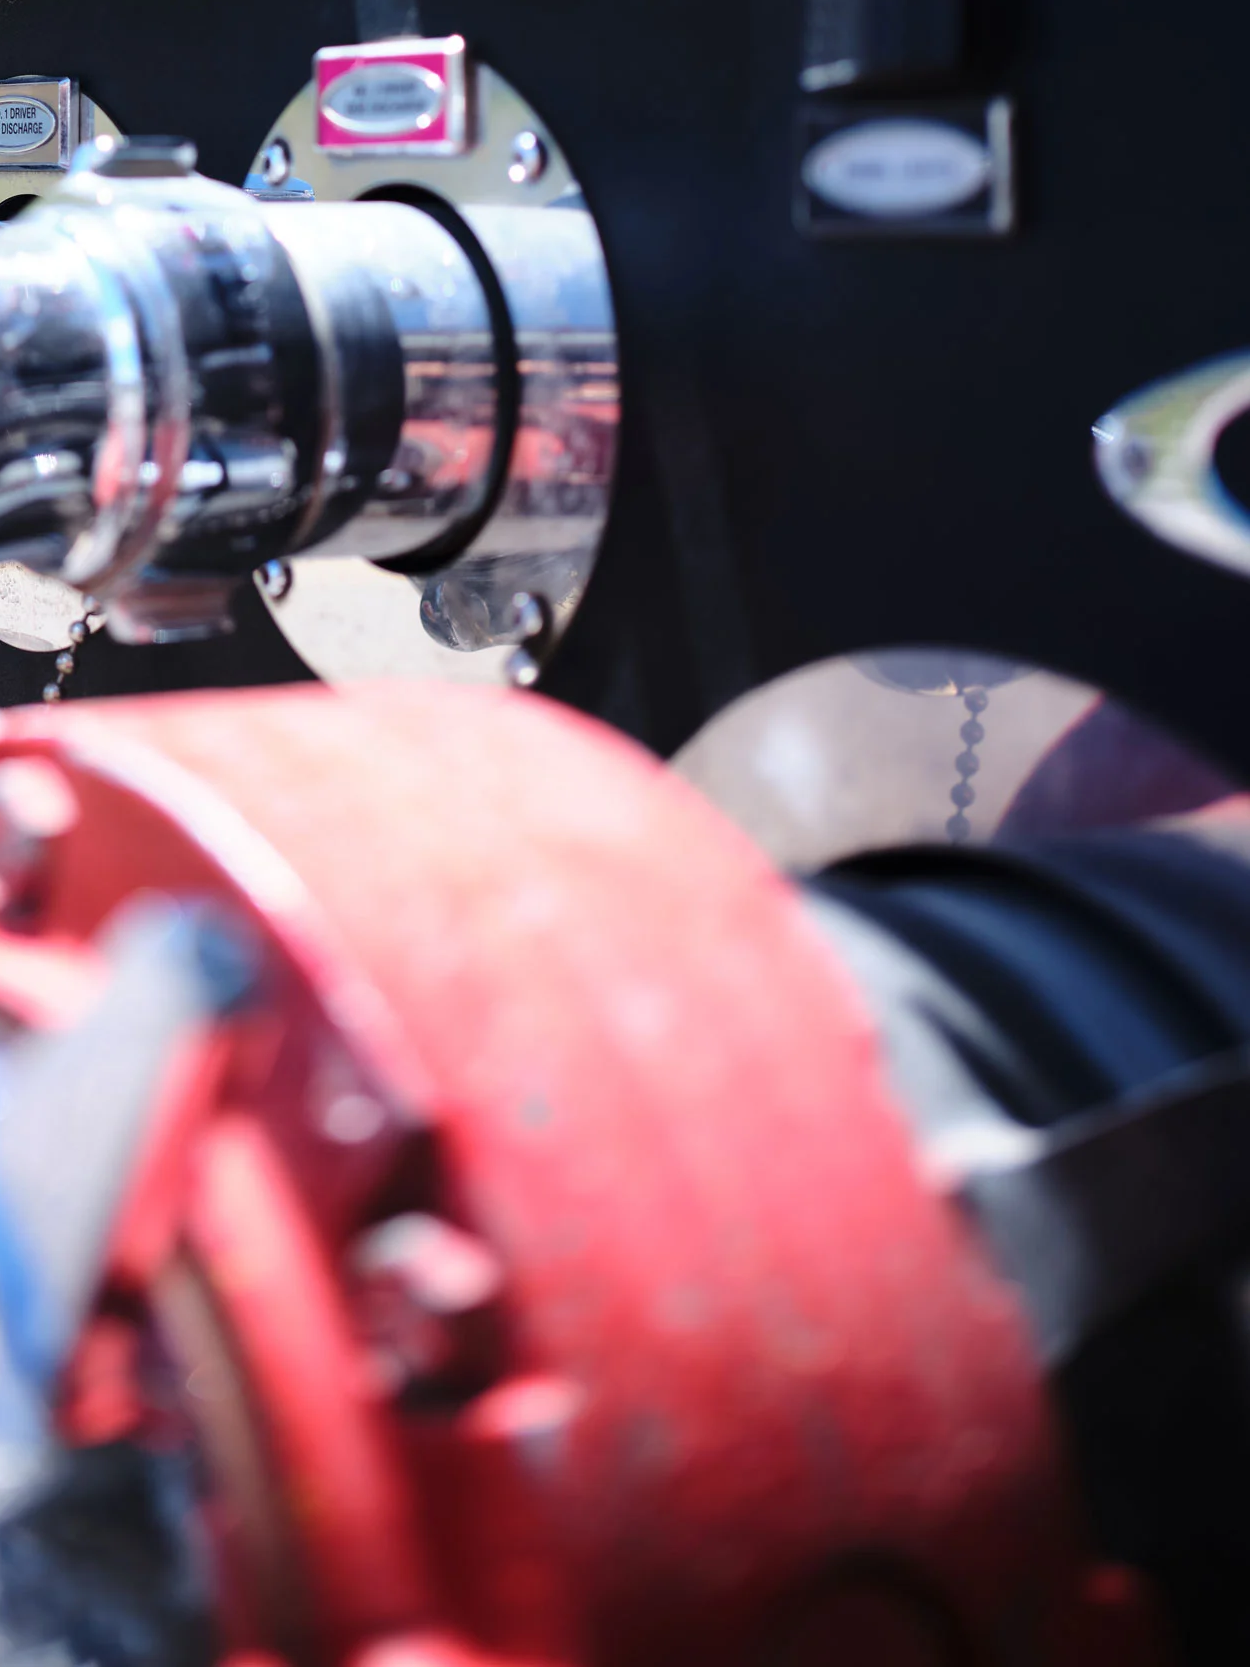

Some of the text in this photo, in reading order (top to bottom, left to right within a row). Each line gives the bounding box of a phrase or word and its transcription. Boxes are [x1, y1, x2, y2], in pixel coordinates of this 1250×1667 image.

[4, 108, 8, 119] 1
[10, 107, 36, 119] DRIVER
[1, 122, 43, 134] DISCHARGE
